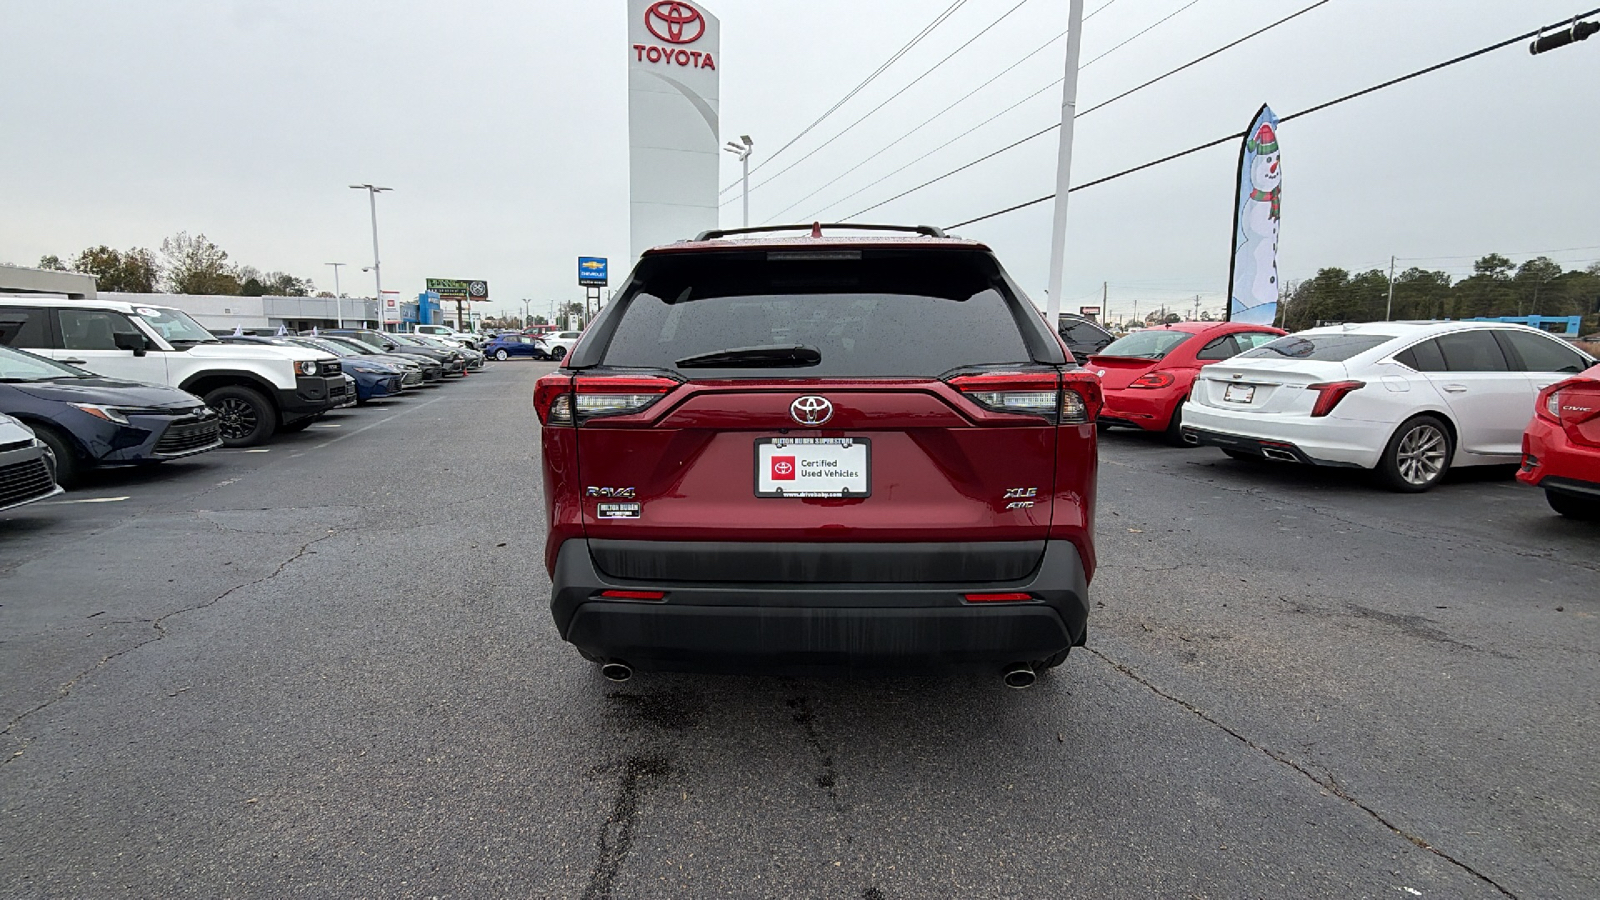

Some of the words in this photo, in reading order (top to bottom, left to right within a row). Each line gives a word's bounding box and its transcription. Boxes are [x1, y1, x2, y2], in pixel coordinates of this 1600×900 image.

[633, 44, 716, 71] TOYOTA
[801, 459, 838, 468] Certified
[801, 470, 823, 478] Used
[824, 470, 859, 478] Vehicles
[586, 486, 636, 498] RAV4
[1002, 487, 1038, 499] XLE
